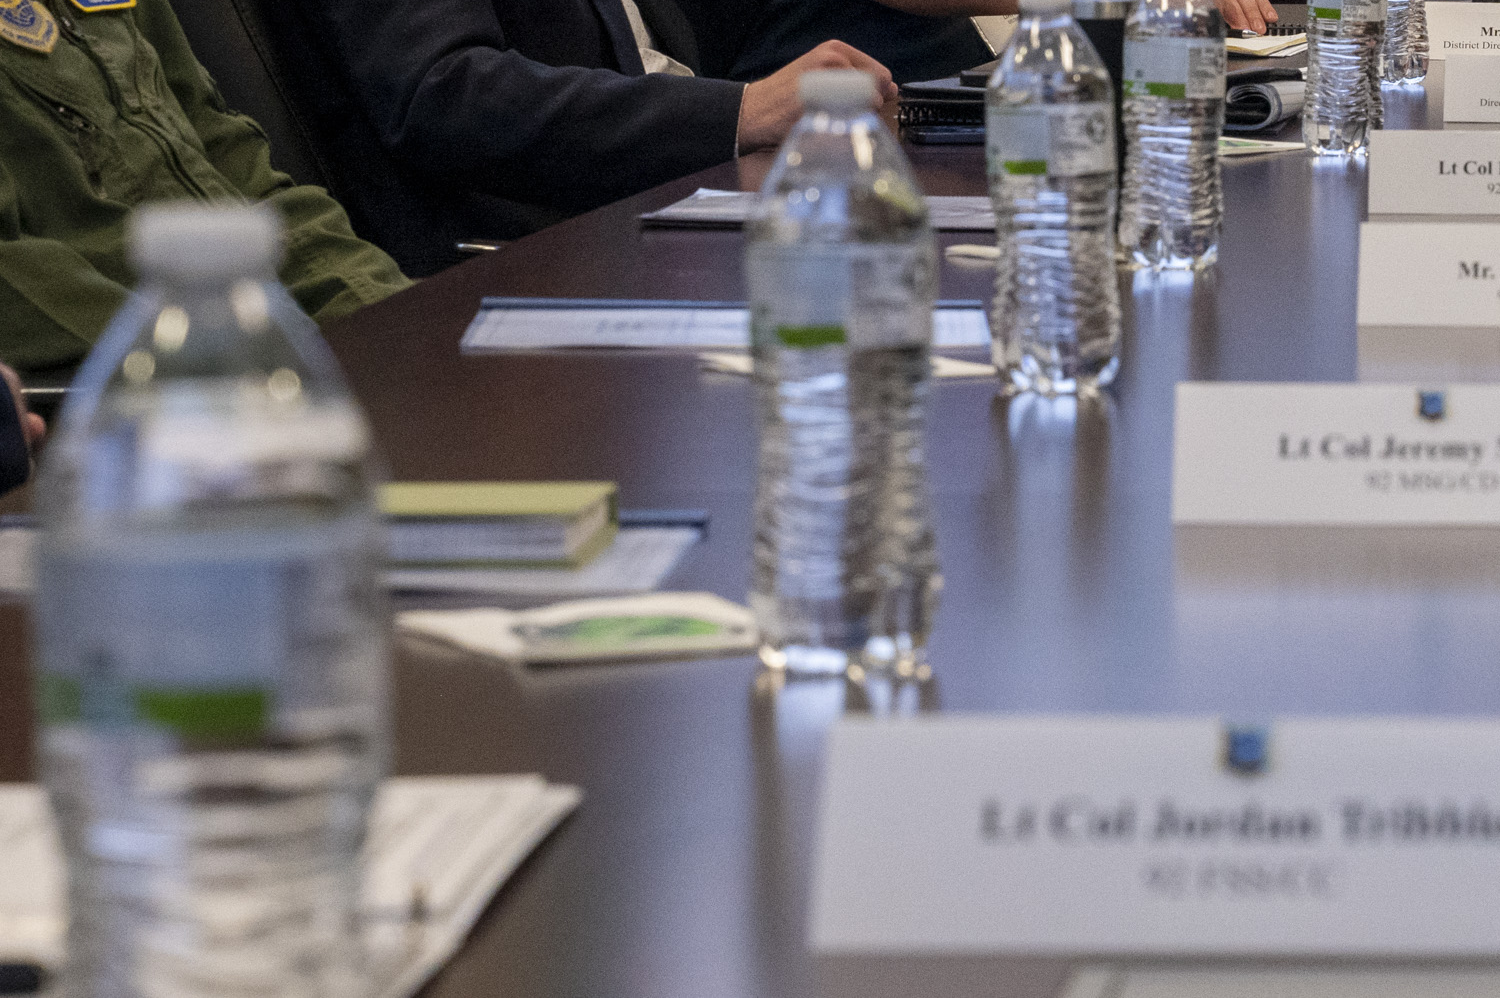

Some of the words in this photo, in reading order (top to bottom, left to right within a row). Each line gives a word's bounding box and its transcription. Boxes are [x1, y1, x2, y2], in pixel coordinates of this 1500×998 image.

[1438, 160, 1458, 176] Lt
[1462, 160, 1493, 176] Col
[1459, 261, 1496, 280] Mr.
